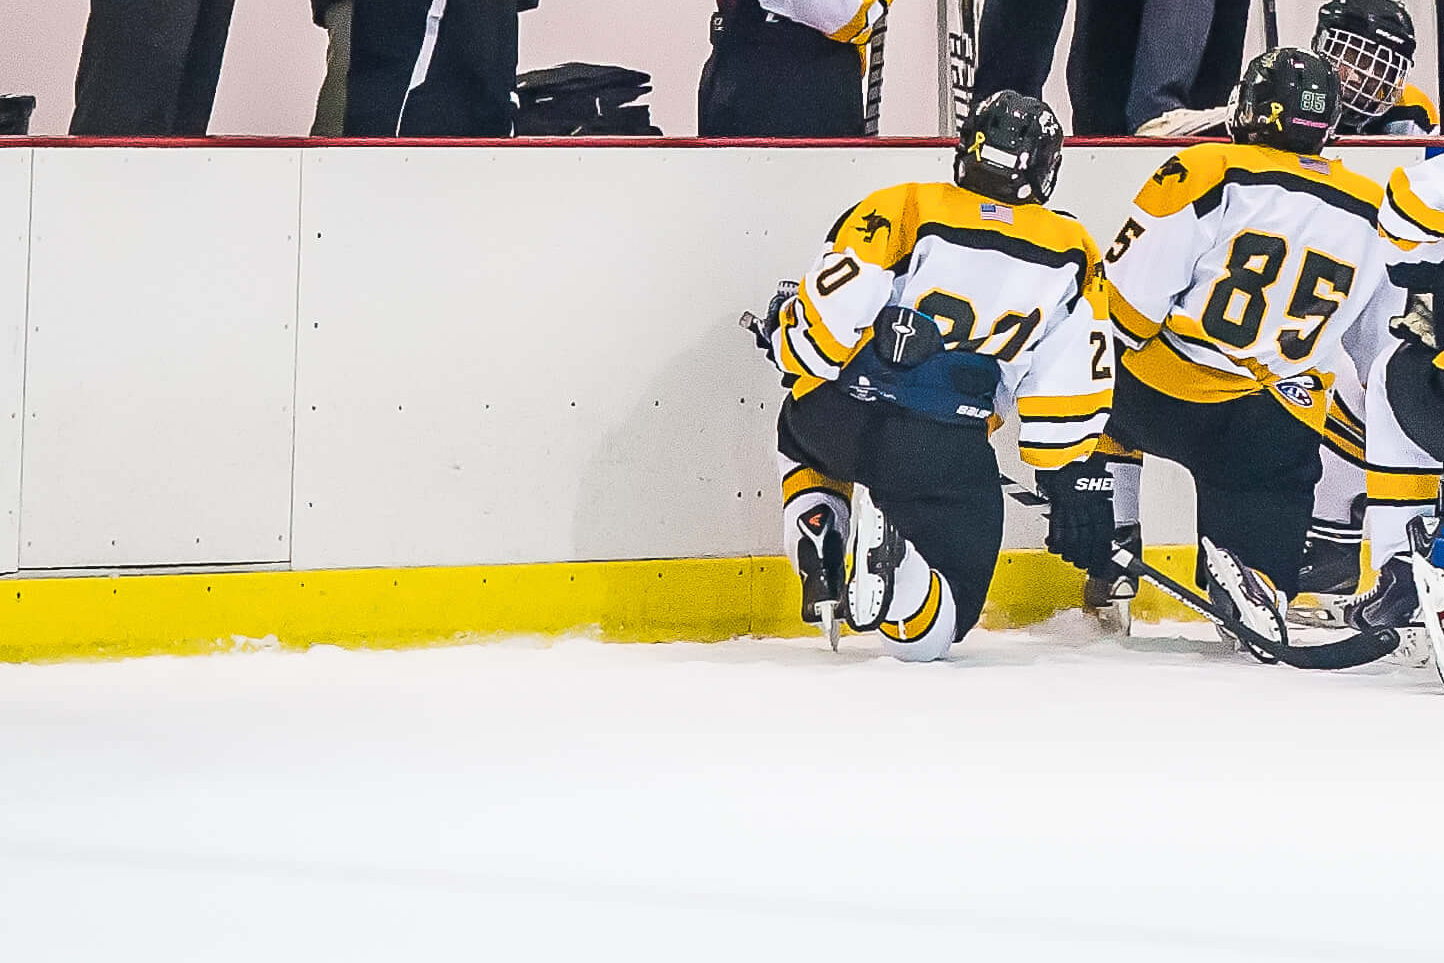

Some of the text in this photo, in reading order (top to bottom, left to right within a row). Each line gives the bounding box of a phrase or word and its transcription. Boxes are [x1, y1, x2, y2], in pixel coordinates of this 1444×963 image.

[1300, 89, 1327, 114] 85
[1104, 216, 1147, 264] 5
[1201, 227, 1358, 363] 85
[1089, 330, 1113, 381] 2
